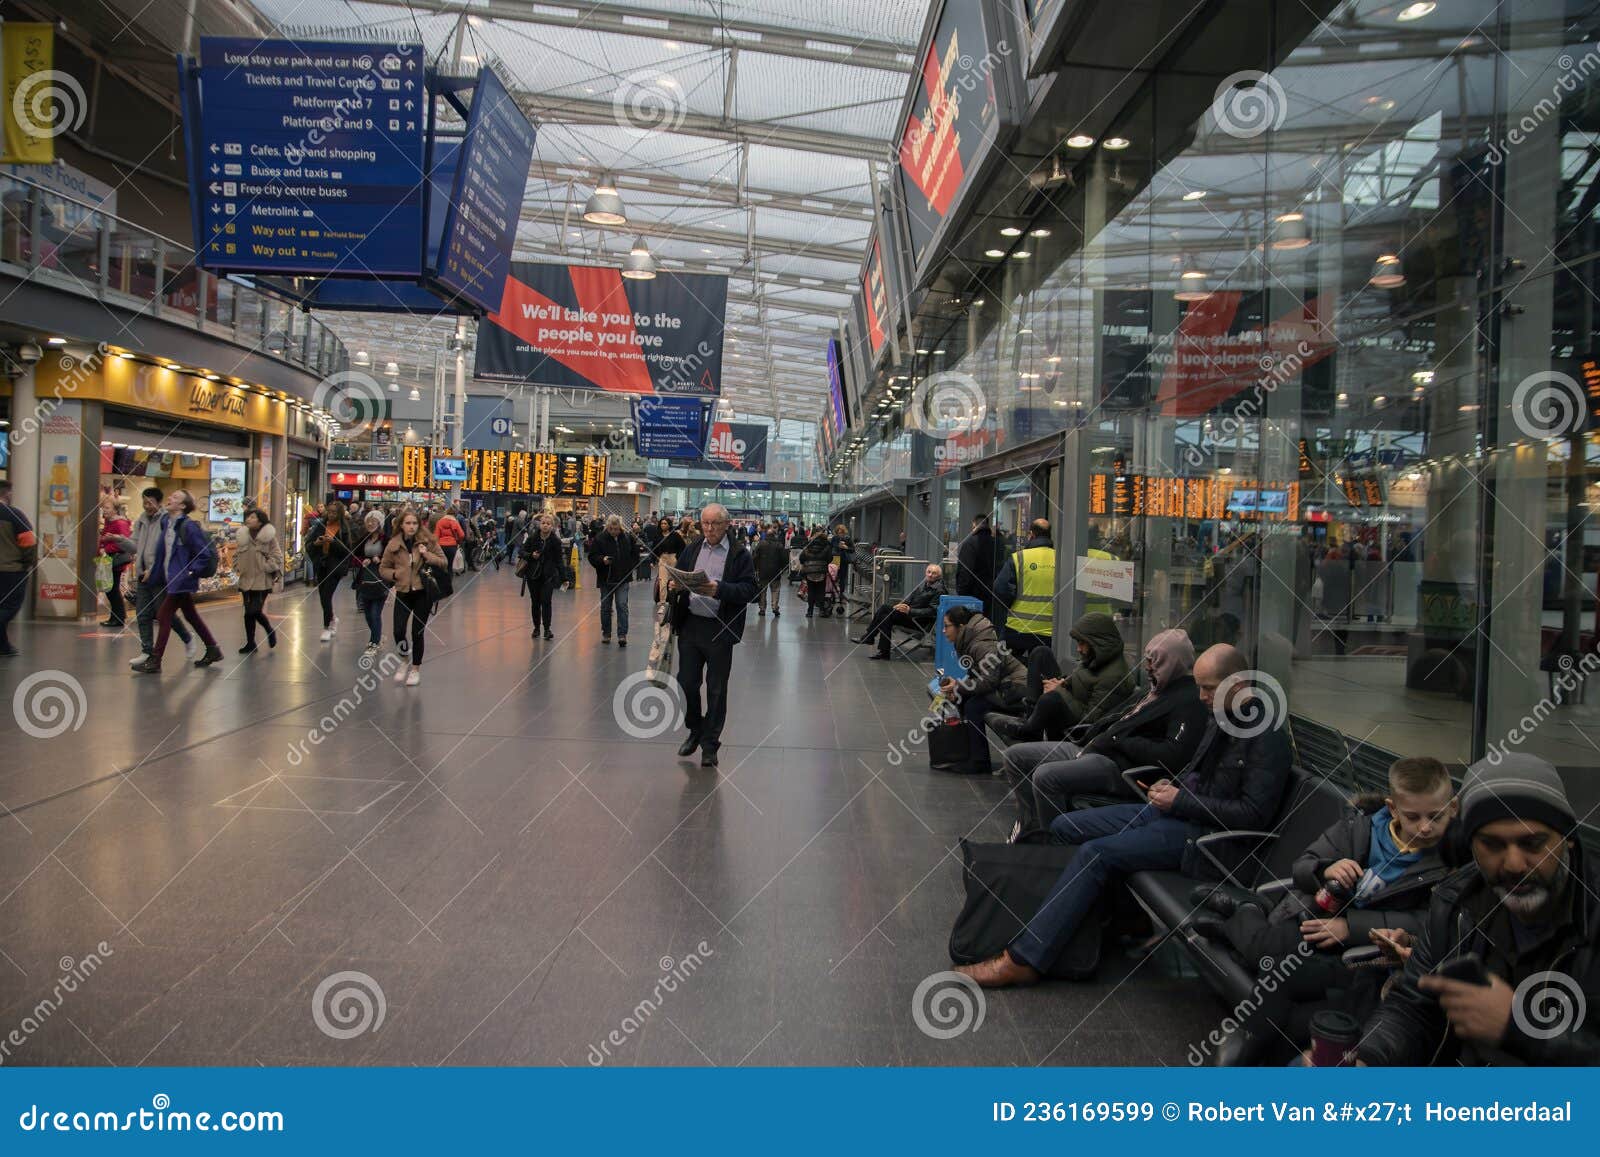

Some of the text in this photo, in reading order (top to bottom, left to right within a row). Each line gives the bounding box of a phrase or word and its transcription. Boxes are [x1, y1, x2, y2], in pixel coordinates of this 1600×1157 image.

[224, 52, 249, 67] Long
[250, 55, 270, 68] stay
[275, 57, 289, 66] car
[292, 56, 312, 69] park
[315, 57, 332, 68] and
[335, 59, 350, 68] car
[245, 73, 282, 86] Tickets
[284, 75, 303, 87] and
[306, 75, 336, 88] Travel
[293, 96, 342, 109] Platforms
[366, 100, 372, 110] 7
[283, 116, 334, 128] Platforms
[344, 119, 363, 130] and
[366, 120, 373, 130] 9
[307, 148, 326, 158] and
[329, 148, 376, 162] shopping
[251, 166, 328, 178] Buses and taxis
[240, 184, 348, 198] Free city centre buses
[252, 205, 300, 218] Metrolink
[252, 226, 276, 238] Way
[278, 228, 296, 237] out
[253, 245, 276, 258] Way
[278, 247, 296, 257] out
[522, 303, 682, 329] We'll take you to the
[538, 326, 664, 348] people you love
[544, 346, 565, 355] places
[620, 351, 645, 360] starting
[709, 431, 746, 454] ello
